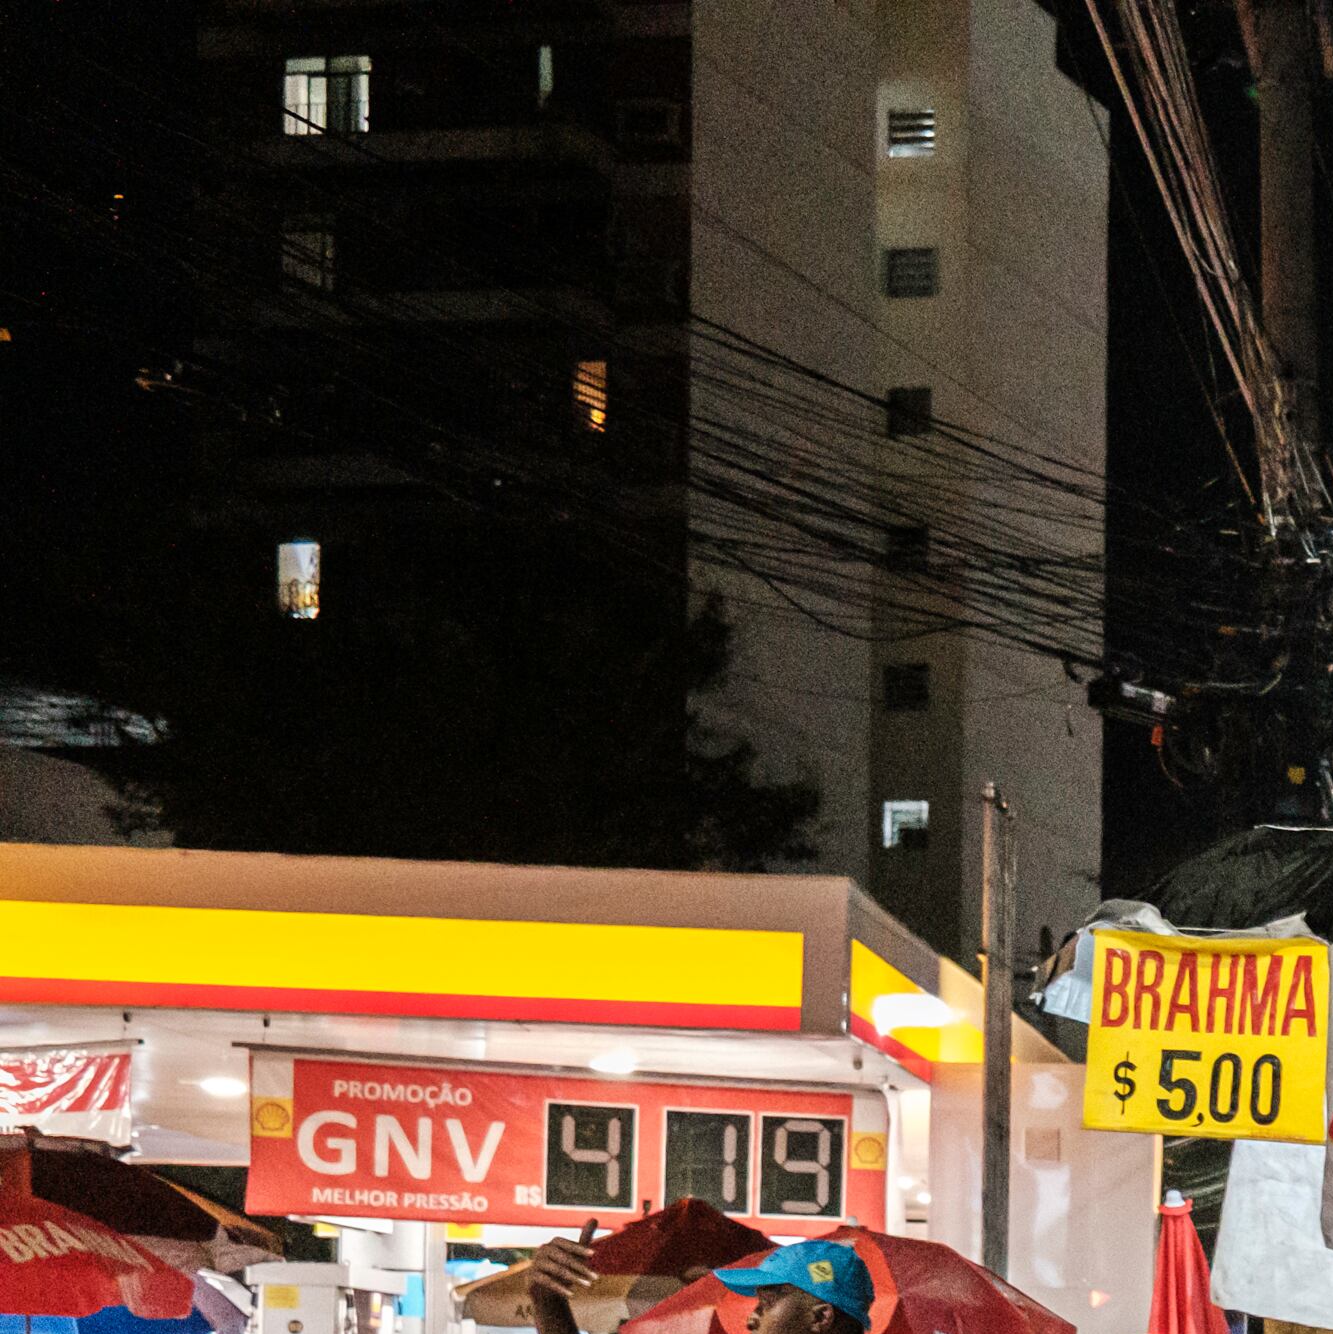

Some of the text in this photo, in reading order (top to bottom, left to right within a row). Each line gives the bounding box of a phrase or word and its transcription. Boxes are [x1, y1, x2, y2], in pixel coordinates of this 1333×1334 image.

[1100, 948, 1318, 1038] BRAHMA
[332, 1079, 473, 1108] PROMOÇÃO
[1113, 1049, 1283, 1128] $ 5,00
[296, 1109, 506, 1184] GNV
[311, 1187, 488, 1213] MELHOR PRESSÃO
[514, 1185, 542, 1207] R$
